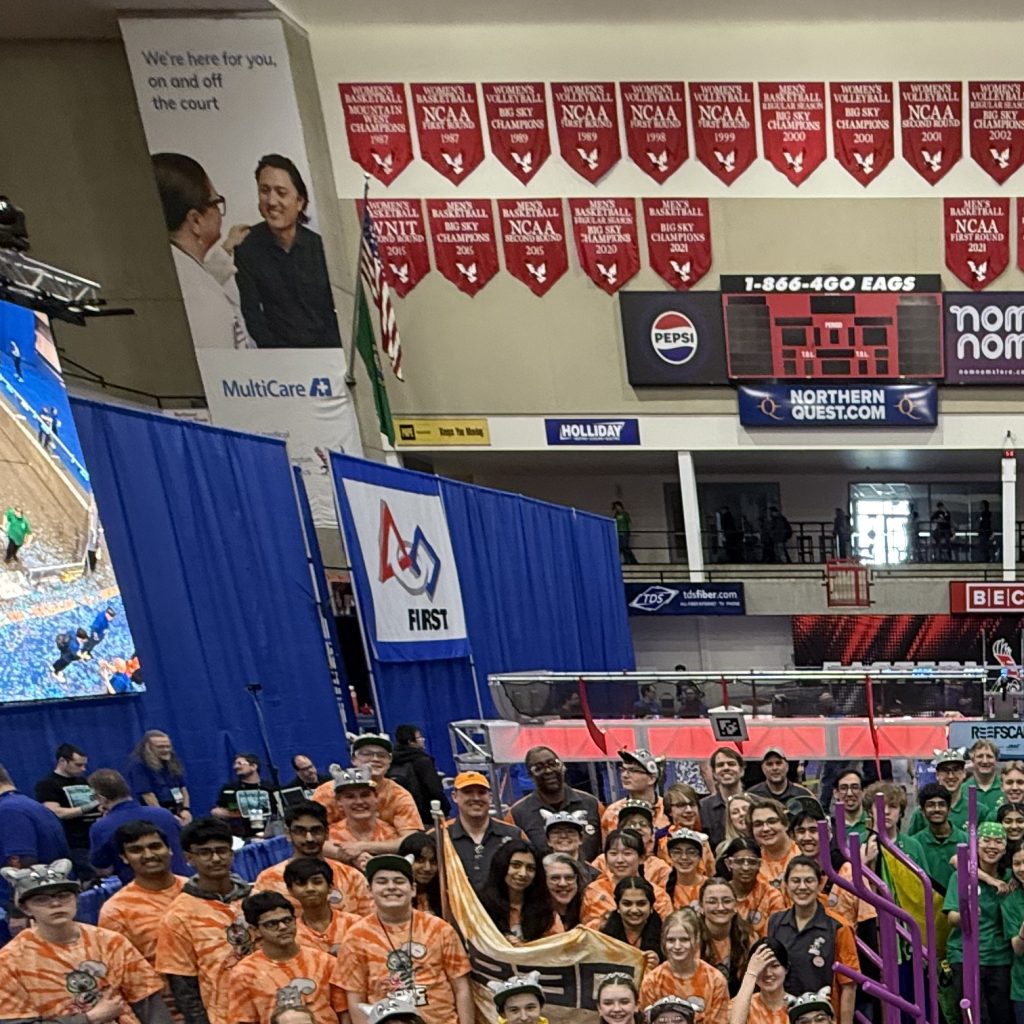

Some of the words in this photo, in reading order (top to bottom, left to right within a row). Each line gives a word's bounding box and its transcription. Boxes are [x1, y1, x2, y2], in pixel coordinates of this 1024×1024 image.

[142, 51, 184, 66] We're
[188, 52, 219, 65] here
[223, 51, 241, 65] for
[247, 55, 277, 69] you,
[148, 76, 166, 88] on
[171, 74, 198, 88] and
[203, 73, 223, 88] off
[153, 96, 176, 110] the
[181, 97, 220, 110] court
[422, 106, 469, 123] NCAA
[561, 105, 607, 122] NCAA
[631, 106, 677, 122] NCAA
[699, 106, 745, 122] NCAA
[845, 107, 861, 118] BIG
[863, 107, 880, 118] SKY
[908, 105, 955, 121] NCAA
[491, 118, 544, 130] CHAMPIONS
[768, 120, 820, 131] CHAMPIONS
[837, 119, 889, 130] CHAMPIONS
[950, 207, 1004, 216] BASKETBALL
[510, 220, 556, 236] NCAA
[660, 223, 675, 233] BIG
[677, 223, 694, 233] SKY
[956, 219, 999, 234] NCAA
[437, 233, 490, 243] CHAMPIONS
[651, 232, 705, 243] CHAMPIONS
[951, 234, 974, 242] FIRST
[976, 234, 1004, 242] ROUND
[745, 276, 855, 291] 1-866-4GO
[861, 276, 915, 291] EAGS
[655, 333, 694, 343] PEPSI
[222, 380, 305, 397] MultiCare
[790, 390, 885, 404] NORTHERN
[791, 405, 885, 420] QUEST.COM
[561, 424, 621, 437] HOLLIDAY
[644, 594, 664, 603] TDS
[683, 590, 737, 599] tdsfiber.com
[408, 608, 448, 630] FIRST
